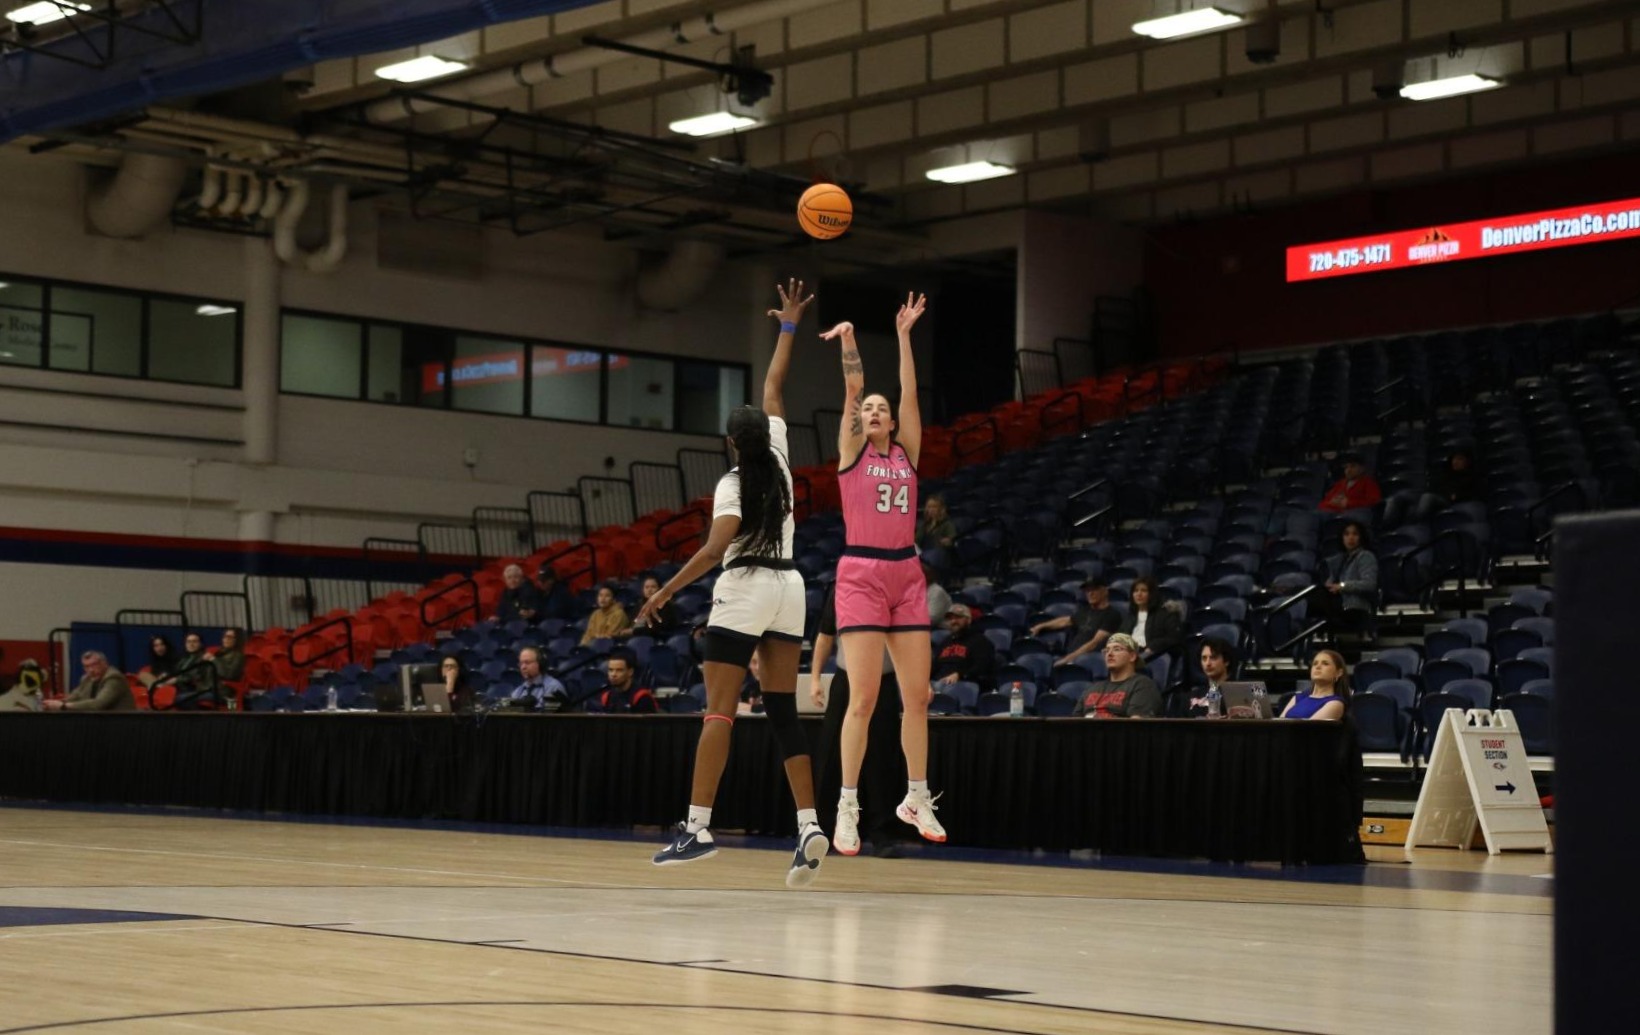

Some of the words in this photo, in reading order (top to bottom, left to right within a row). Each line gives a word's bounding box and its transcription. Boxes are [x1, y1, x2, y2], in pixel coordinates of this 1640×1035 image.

[1309, 243, 1391, 272] 720-475-1471
[1408, 244, 1437, 261] DENVER
[877, 483, 909, 514] 34
[1481, 740, 1505, 749] STUDENT
[1485, 750, 1508, 759] SECTION
